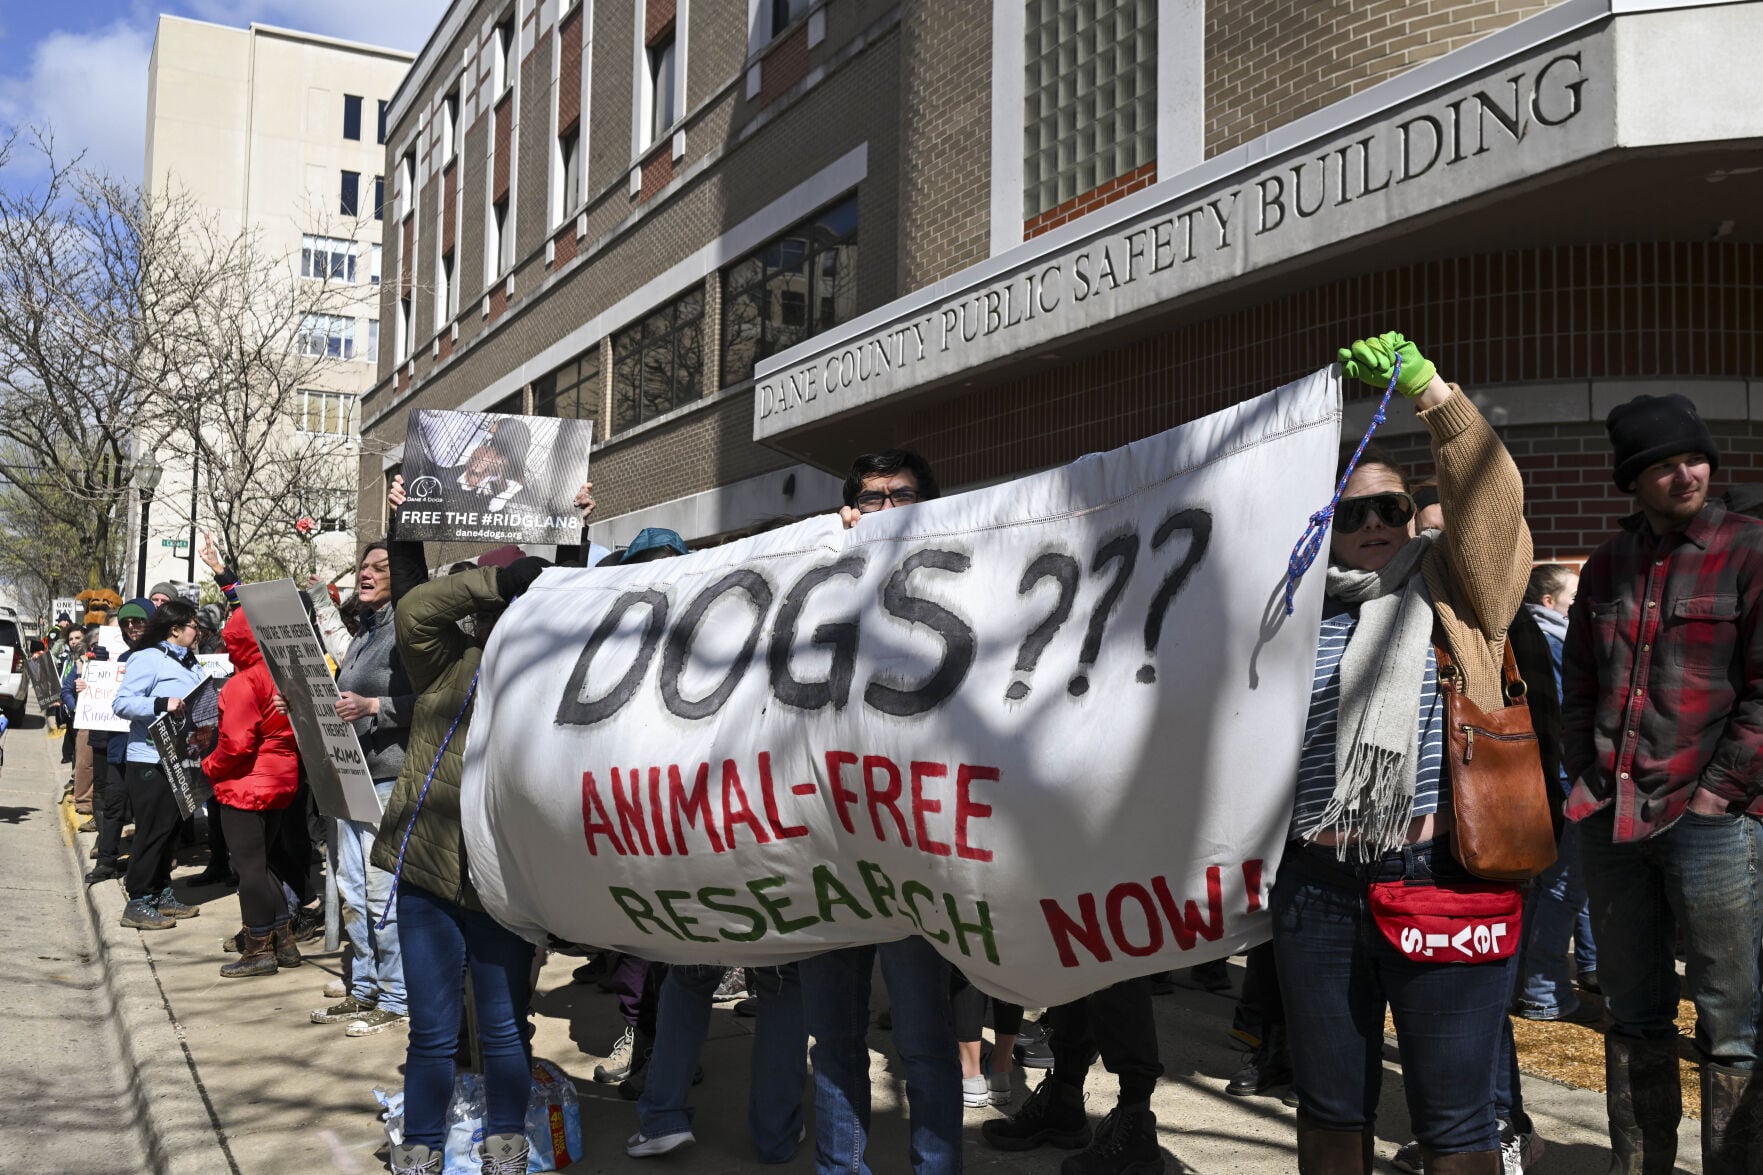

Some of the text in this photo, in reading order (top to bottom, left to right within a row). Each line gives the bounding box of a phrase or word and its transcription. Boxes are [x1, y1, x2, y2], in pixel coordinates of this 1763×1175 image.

[760, 49, 1588, 420] DANE COUNTY PUBLIC SAFETY BUILDING
[401, 511, 578, 529] FREE THE #RIDGLAN8
[456, 529, 523, 540] dane4dogs.org
[310, 703, 336, 718] ILLAIN
[156, 720, 168, 744] FREE
[165, 743, 178, 763] THE
[581, 749, 1001, 863] ANIMAL-FREE
[608, 859, 1000, 967] RESEARCH
